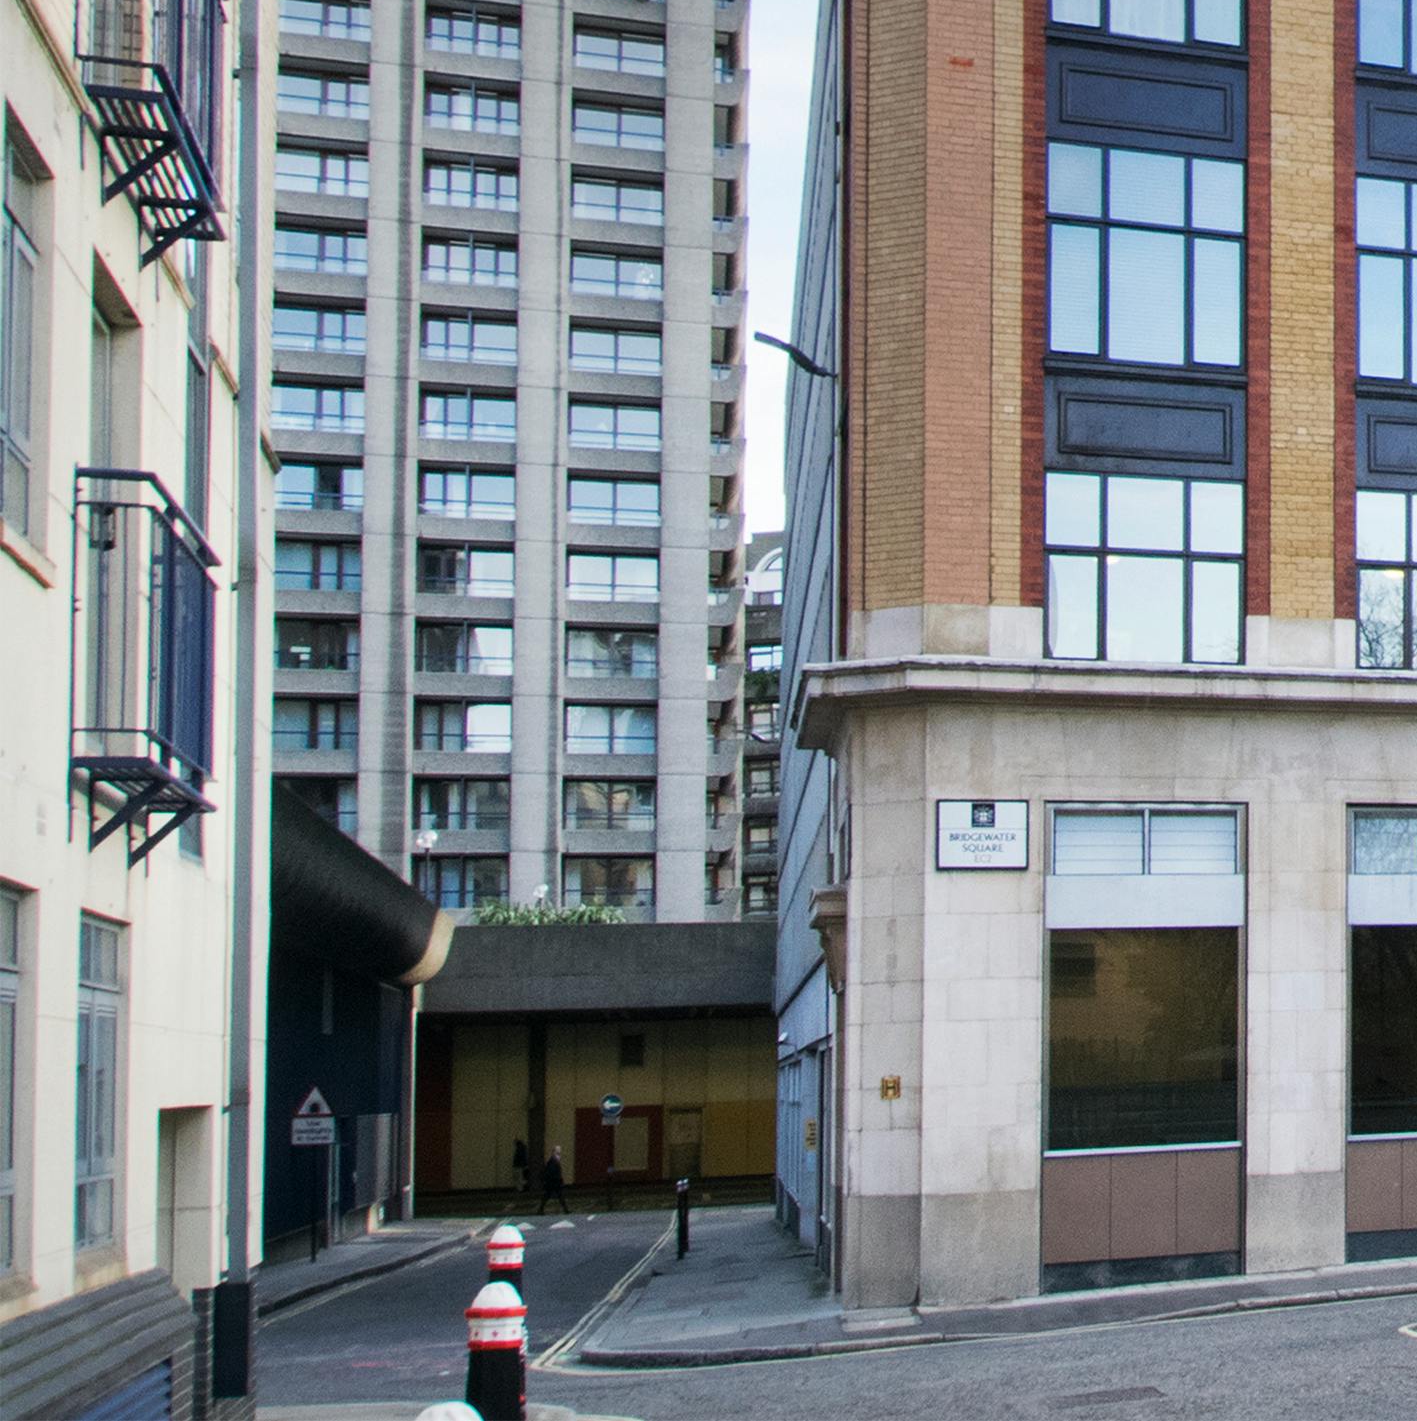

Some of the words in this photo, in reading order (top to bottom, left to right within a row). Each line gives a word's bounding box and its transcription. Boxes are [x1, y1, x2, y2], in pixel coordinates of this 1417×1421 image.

[948, 833, 1016, 842] BRIDGEWATER
[962, 843, 1004, 853] SQUARE
[974, 854, 993, 863] EC2
